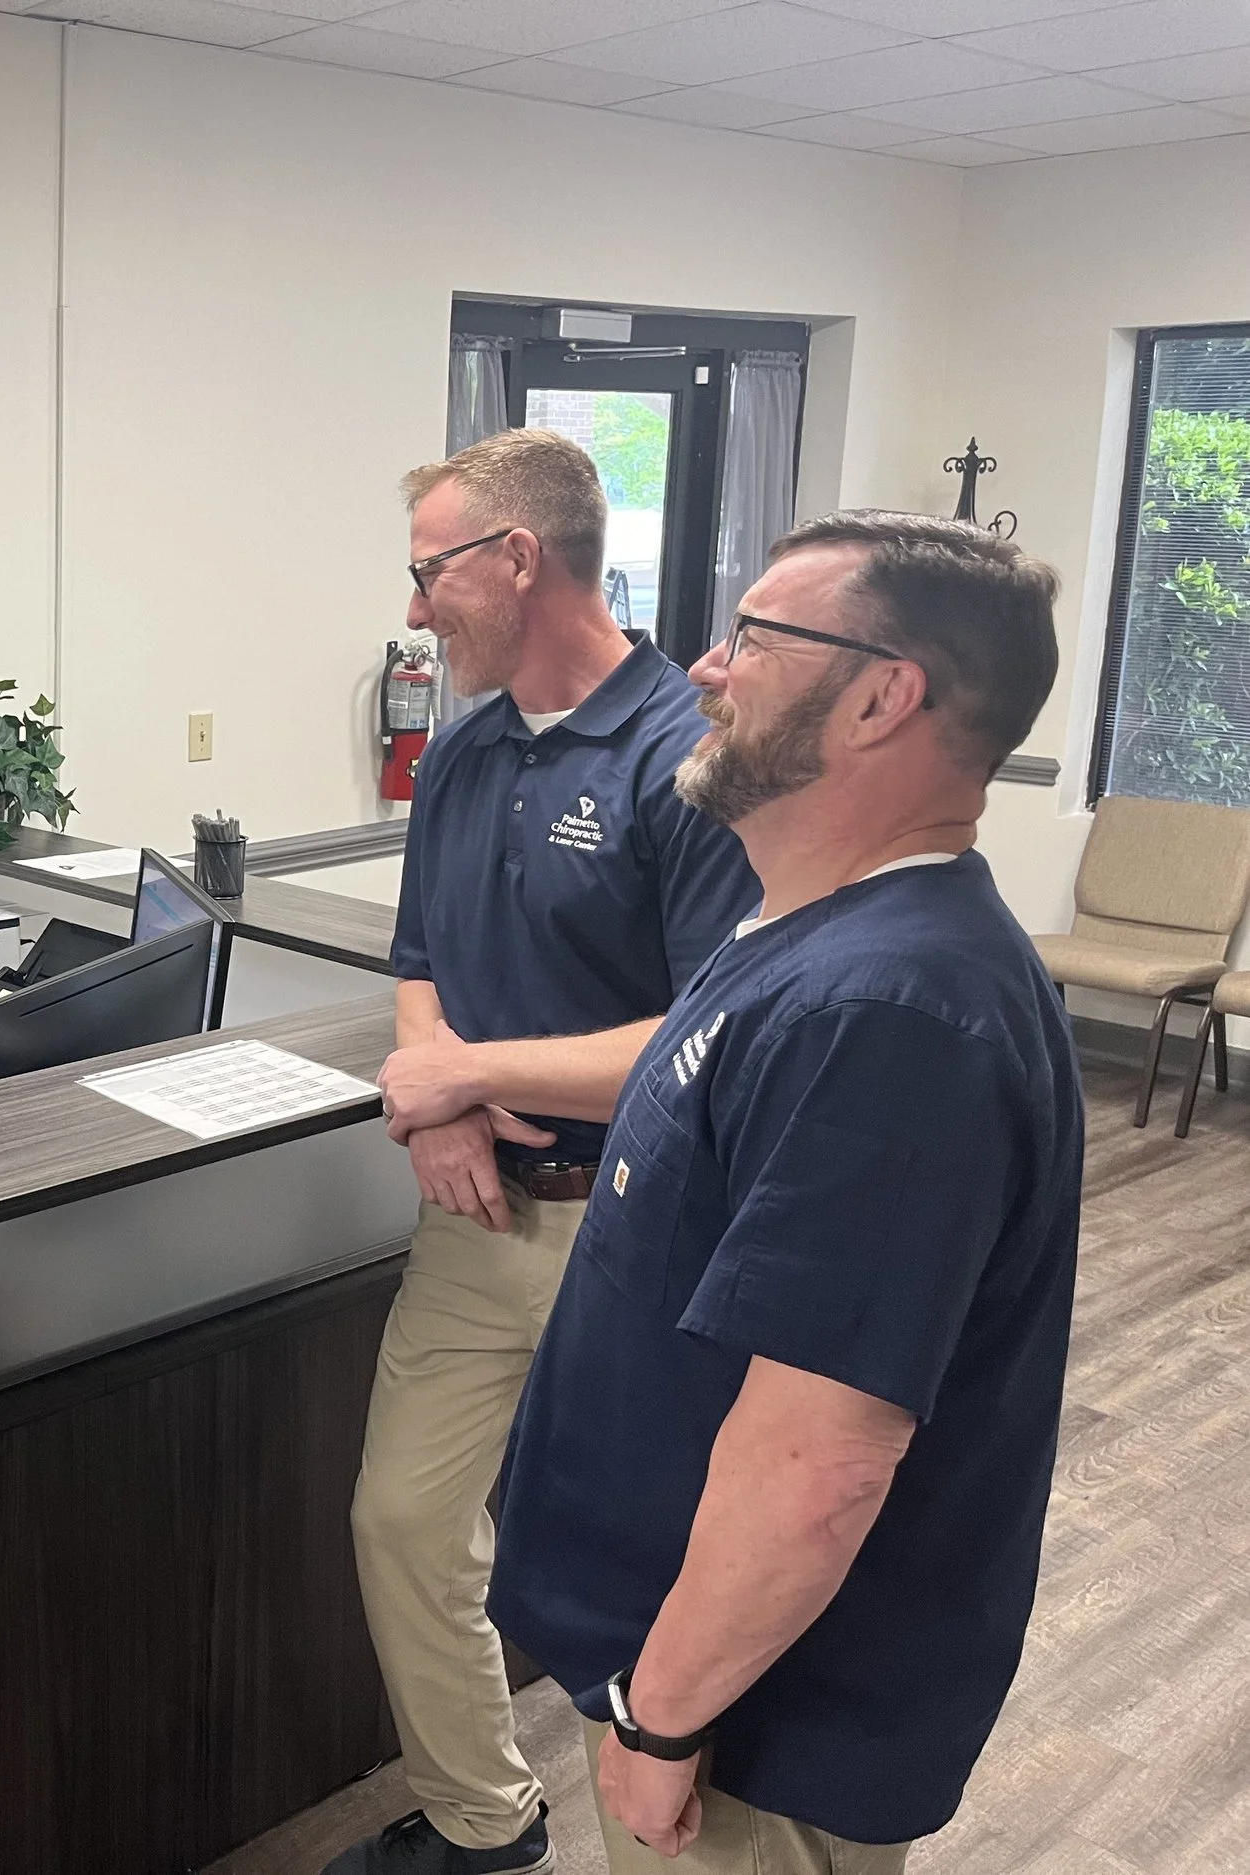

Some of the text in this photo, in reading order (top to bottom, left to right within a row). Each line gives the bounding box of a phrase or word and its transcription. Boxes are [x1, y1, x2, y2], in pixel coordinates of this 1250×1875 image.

[561, 813, 600, 830] Palmetto
[550, 822, 604, 842] Chiropractic
[573, 840, 598, 851] Center
